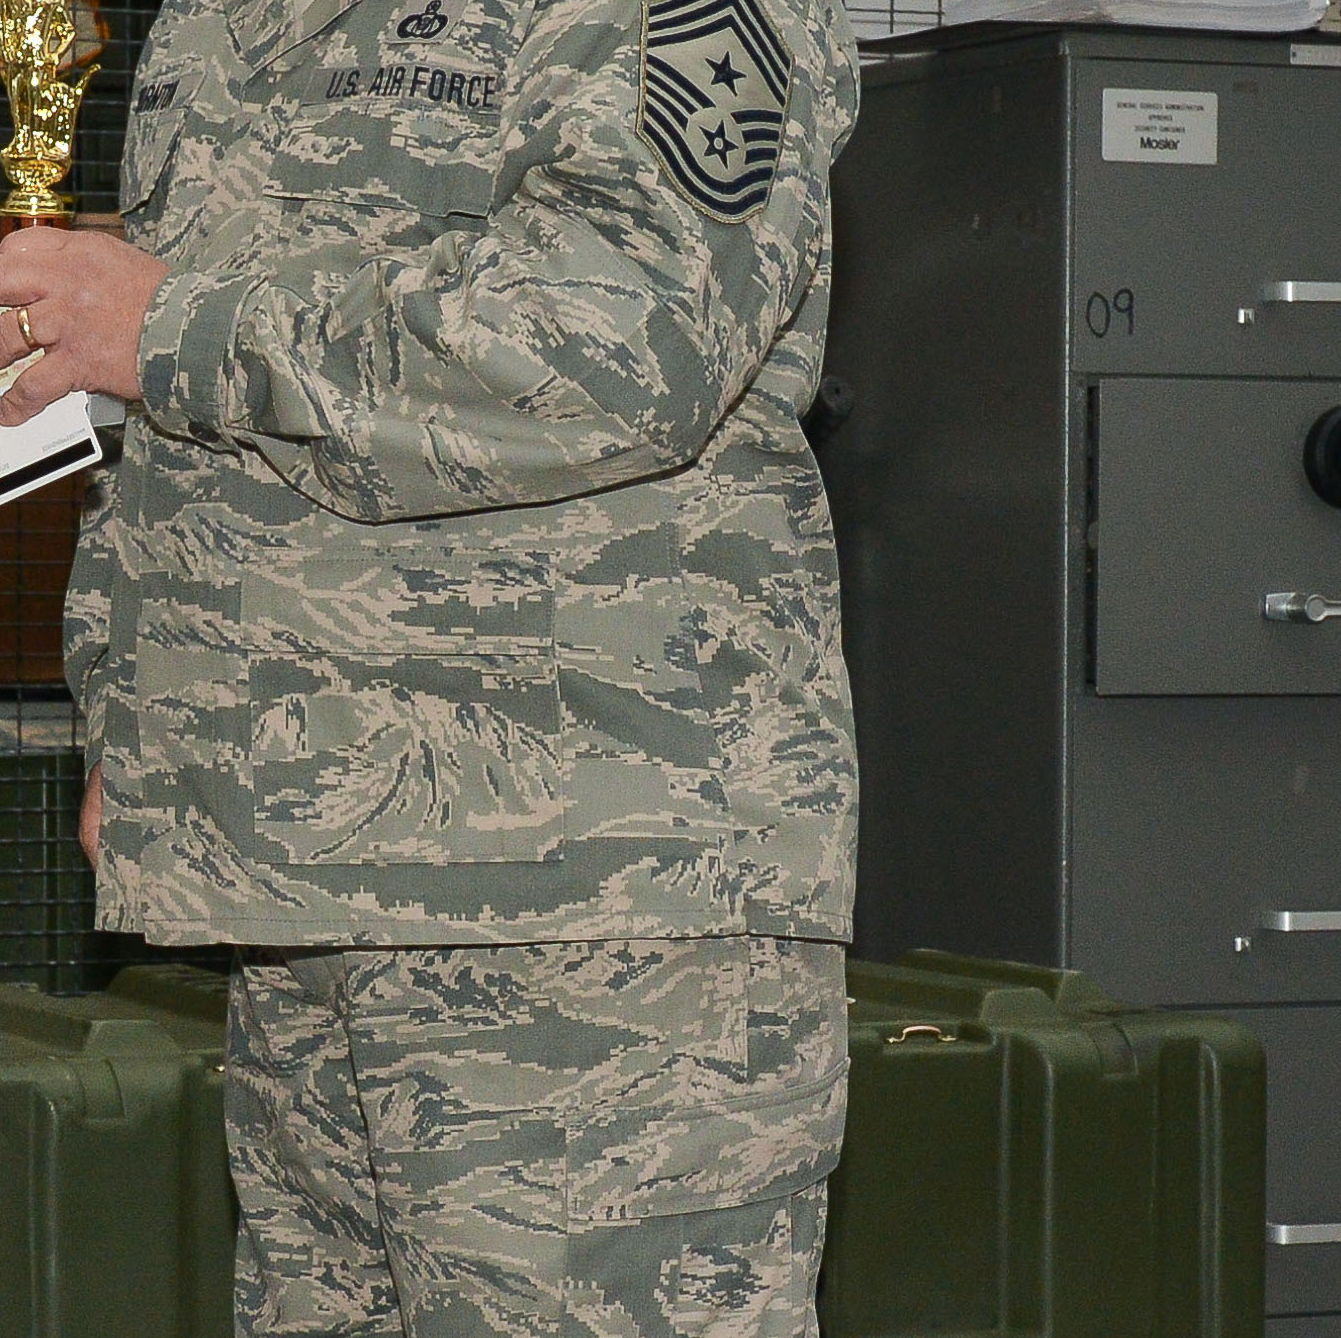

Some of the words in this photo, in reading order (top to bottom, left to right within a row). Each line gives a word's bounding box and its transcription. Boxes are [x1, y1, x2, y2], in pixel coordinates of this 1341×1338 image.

[367, 65, 407, 98] AIR
[410, 64, 498, 108] FORCE
[1085, 288, 1134, 339] 09
